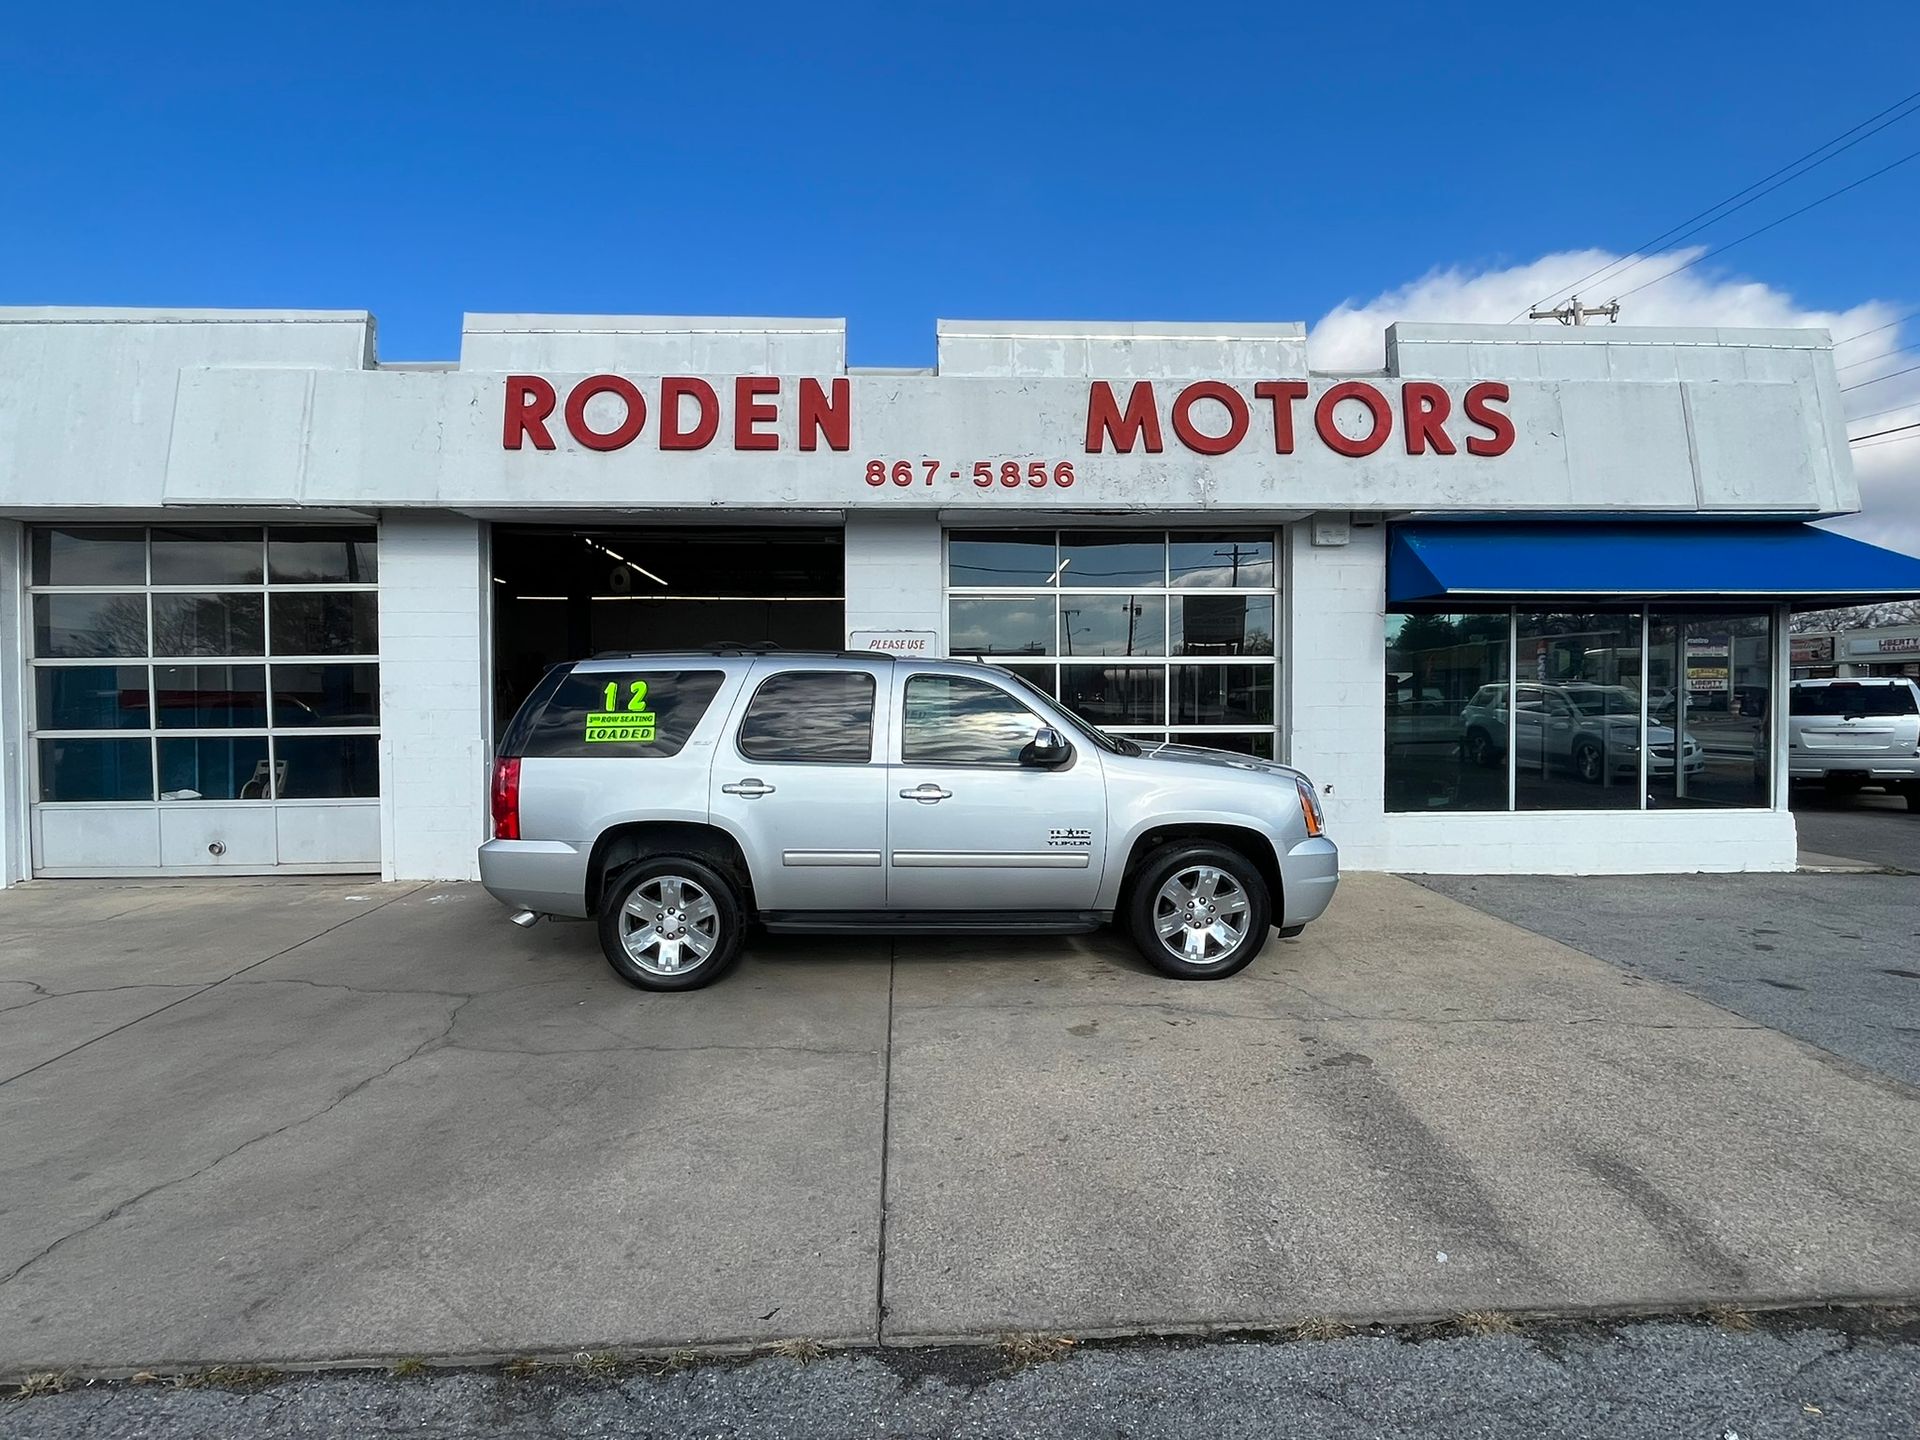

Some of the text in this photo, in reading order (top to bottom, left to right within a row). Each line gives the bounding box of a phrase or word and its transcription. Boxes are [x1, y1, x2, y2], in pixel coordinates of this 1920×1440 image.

[503, 374, 1515, 457] RODEN MOTORS
[865, 460, 1075, 488] 867-5856
[869, 639, 925, 650] PLEASE USE
[1879, 637, 1919, 646] LIBERTY
[620, 715, 653, 723] SEATING
[588, 729, 651, 740] LOADED
